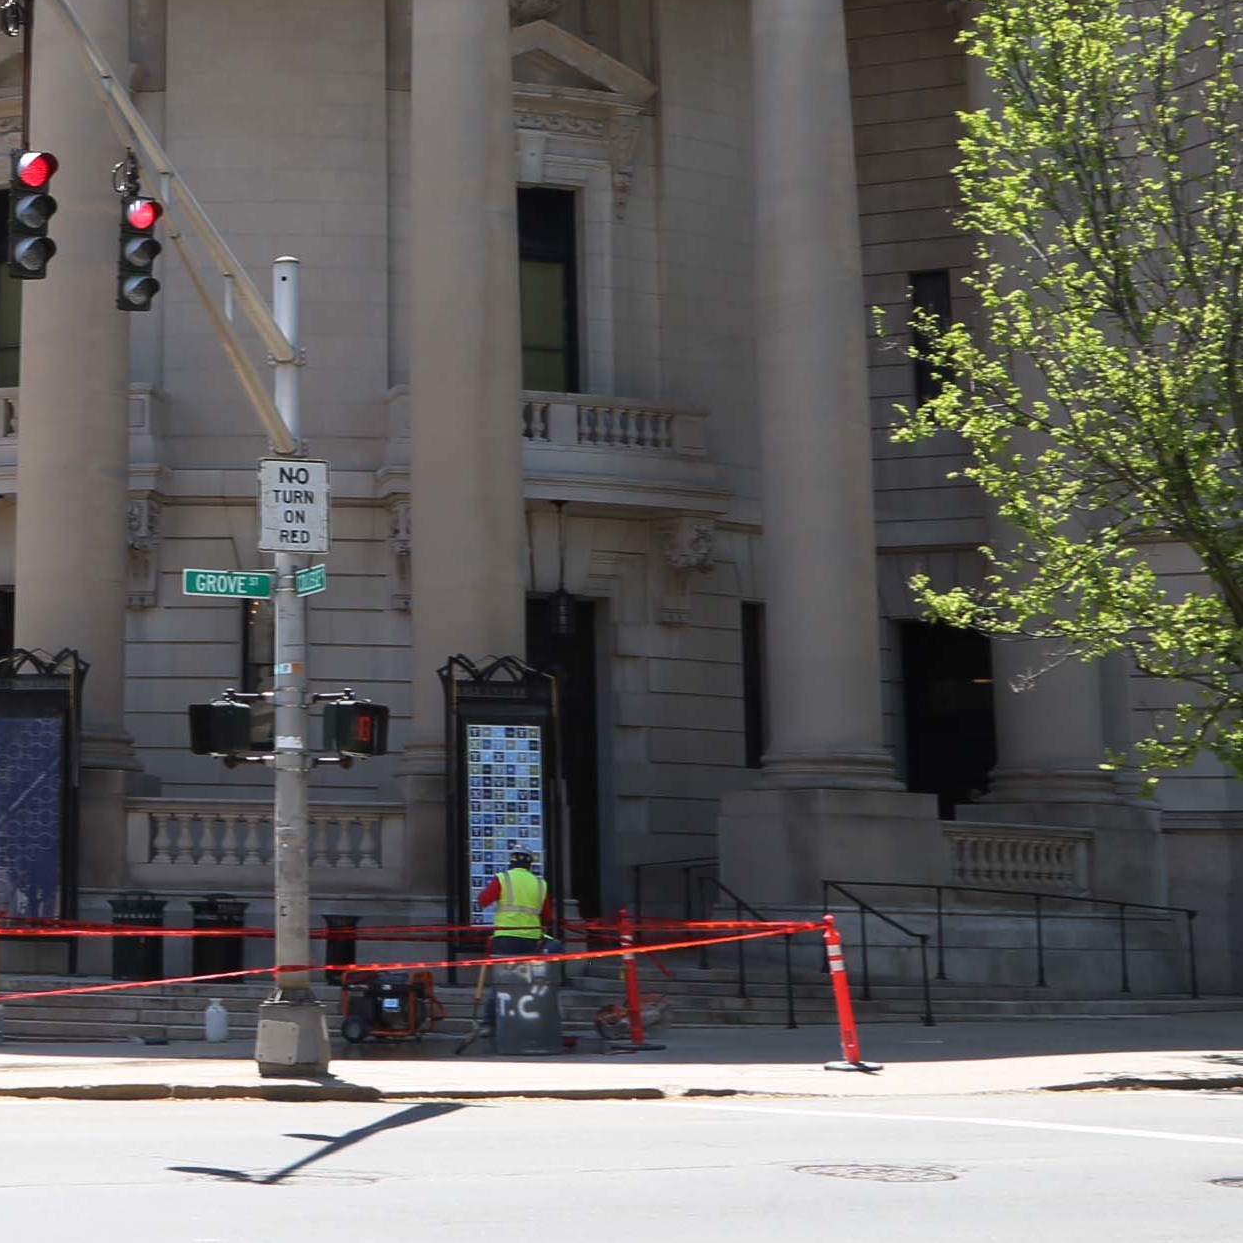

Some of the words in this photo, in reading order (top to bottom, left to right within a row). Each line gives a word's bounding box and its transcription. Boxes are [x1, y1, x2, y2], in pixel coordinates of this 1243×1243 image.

[279, 467, 310, 485] NO
[272, 489, 315, 505] TURN
[283, 509, 306, 524] ON
[279, 529, 311, 544] RED
[195, 573, 248, 594] GROVE
[248, 576, 259, 586] ST
